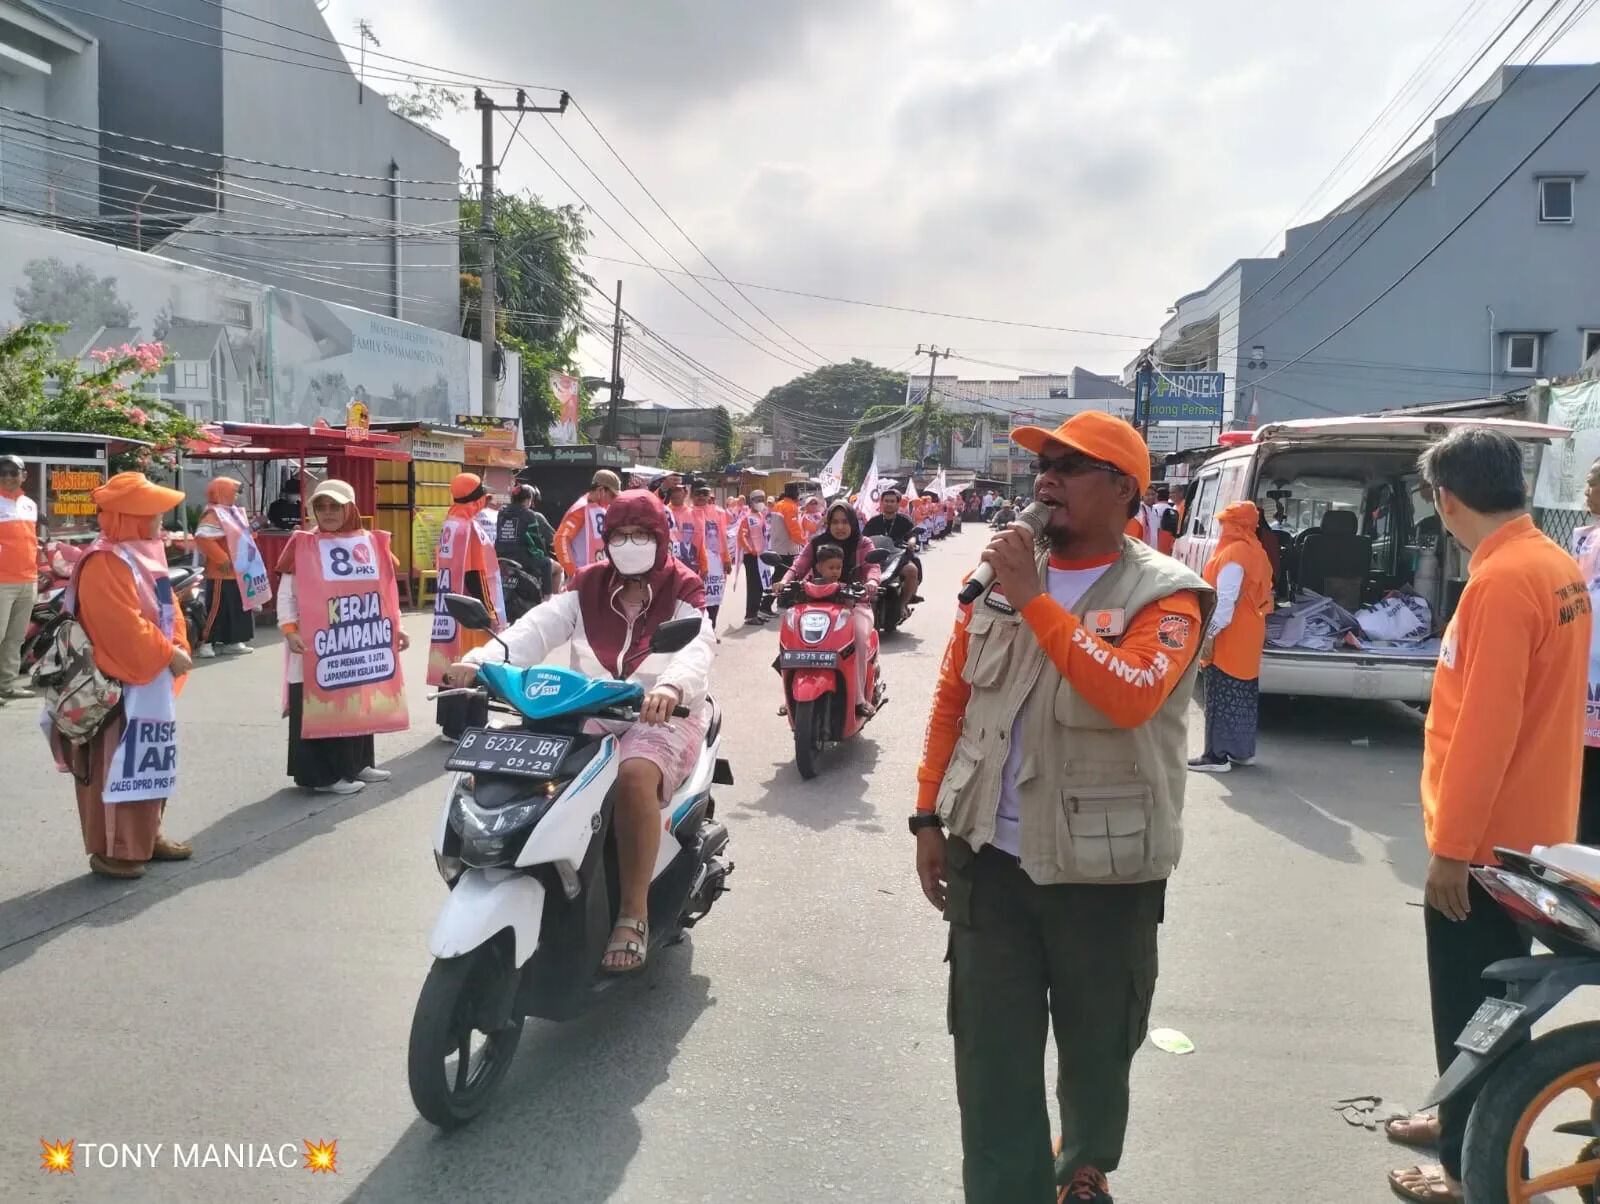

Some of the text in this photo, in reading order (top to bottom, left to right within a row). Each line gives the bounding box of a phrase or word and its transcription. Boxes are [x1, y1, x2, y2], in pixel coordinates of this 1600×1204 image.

[352, 334, 381, 353] FAMILY
[1168, 375, 1219, 398] APOTEK
[330, 547, 353, 576] 8
[355, 566, 375, 575] PKS
[243, 573, 256, 598] 2
[328, 593, 380, 624] KERJA
[314, 618, 391, 656] GAMPANG
[324, 669, 356, 682] LAPANGAN
[357, 665, 374, 677] KERJA
[537, 673, 560, 682] YAMAHA
[121, 718, 137, 779] 1
[462, 735, 563, 757] B 6234 JBK
[110, 780, 131, 793] CALEG
[133, 778, 152, 790] DPRD
[154, 777, 168, 789] PKS
